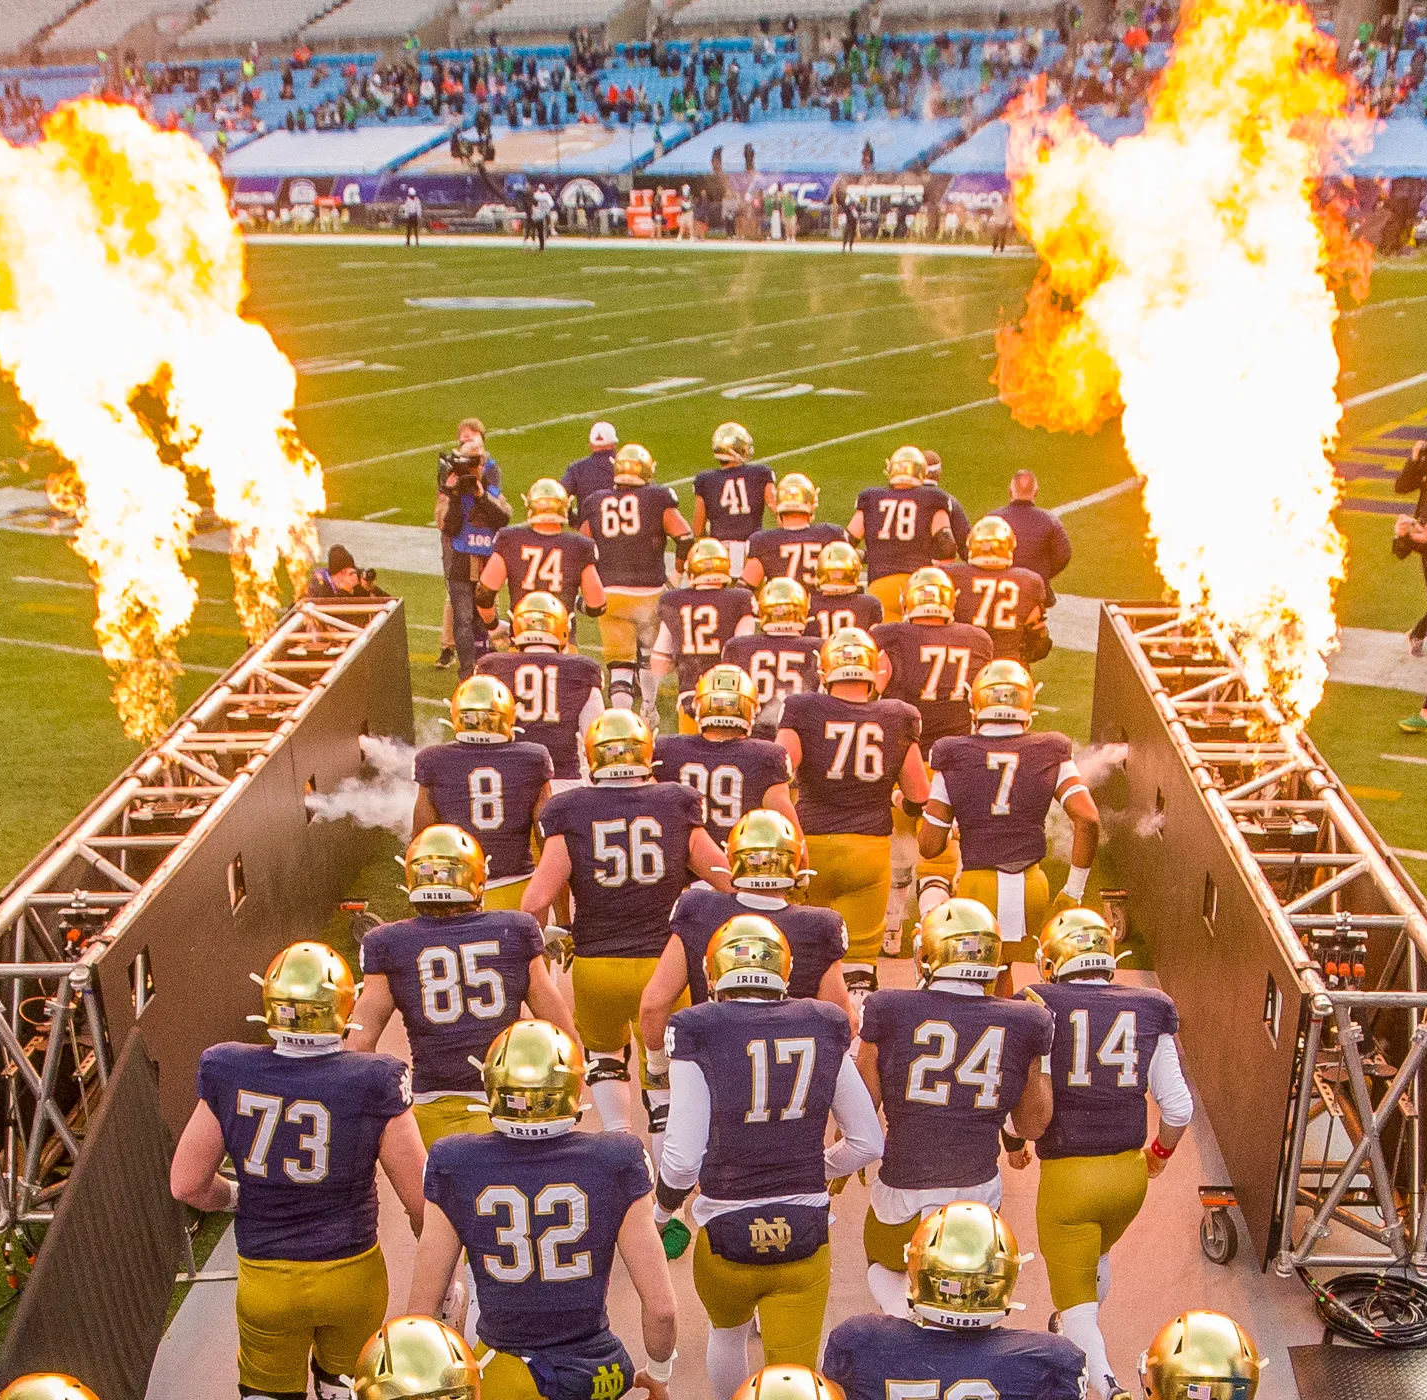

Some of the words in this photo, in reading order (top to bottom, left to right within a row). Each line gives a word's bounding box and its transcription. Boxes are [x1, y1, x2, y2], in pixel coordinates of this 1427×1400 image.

[600, 494, 642, 539] 69
[720, 477, 752, 515] 41
[878, 498, 918, 541] 78
[521, 544, 564, 593] 74
[780, 541, 821, 592] 75
[680, 604, 721, 656] 12
[973, 577, 1021, 631] 72
[514, 664, 561, 724] 91
[750, 650, 806, 704] 65
[920, 644, 972, 702] 77
[608, 769, 636, 778] IRISH
[825, 720, 885, 783] 76
[468, 766, 505, 831] 8
[986, 751, 1020, 816] 7
[591, 815, 666, 888] 56
[422, 892, 452, 901] IRISH
[750, 880, 778, 889] IRISH
[416, 940, 507, 1025] 85
[735, 974, 769, 985] IRISH
[959, 968, 990, 980] IRISH
[1079, 957, 1109, 969] IRISH
[281, 1035, 316, 1046] IRISH
[905, 1019, 1007, 1110] 24
[1068, 1008, 1140, 1088] 14
[744, 1036, 816, 1124] 17
[236, 1088, 332, 1185] 73
[508, 1126, 550, 1137] IRISH
[475, 1182, 594, 1283] 32
[938, 1314, 982, 1328] IRISH
